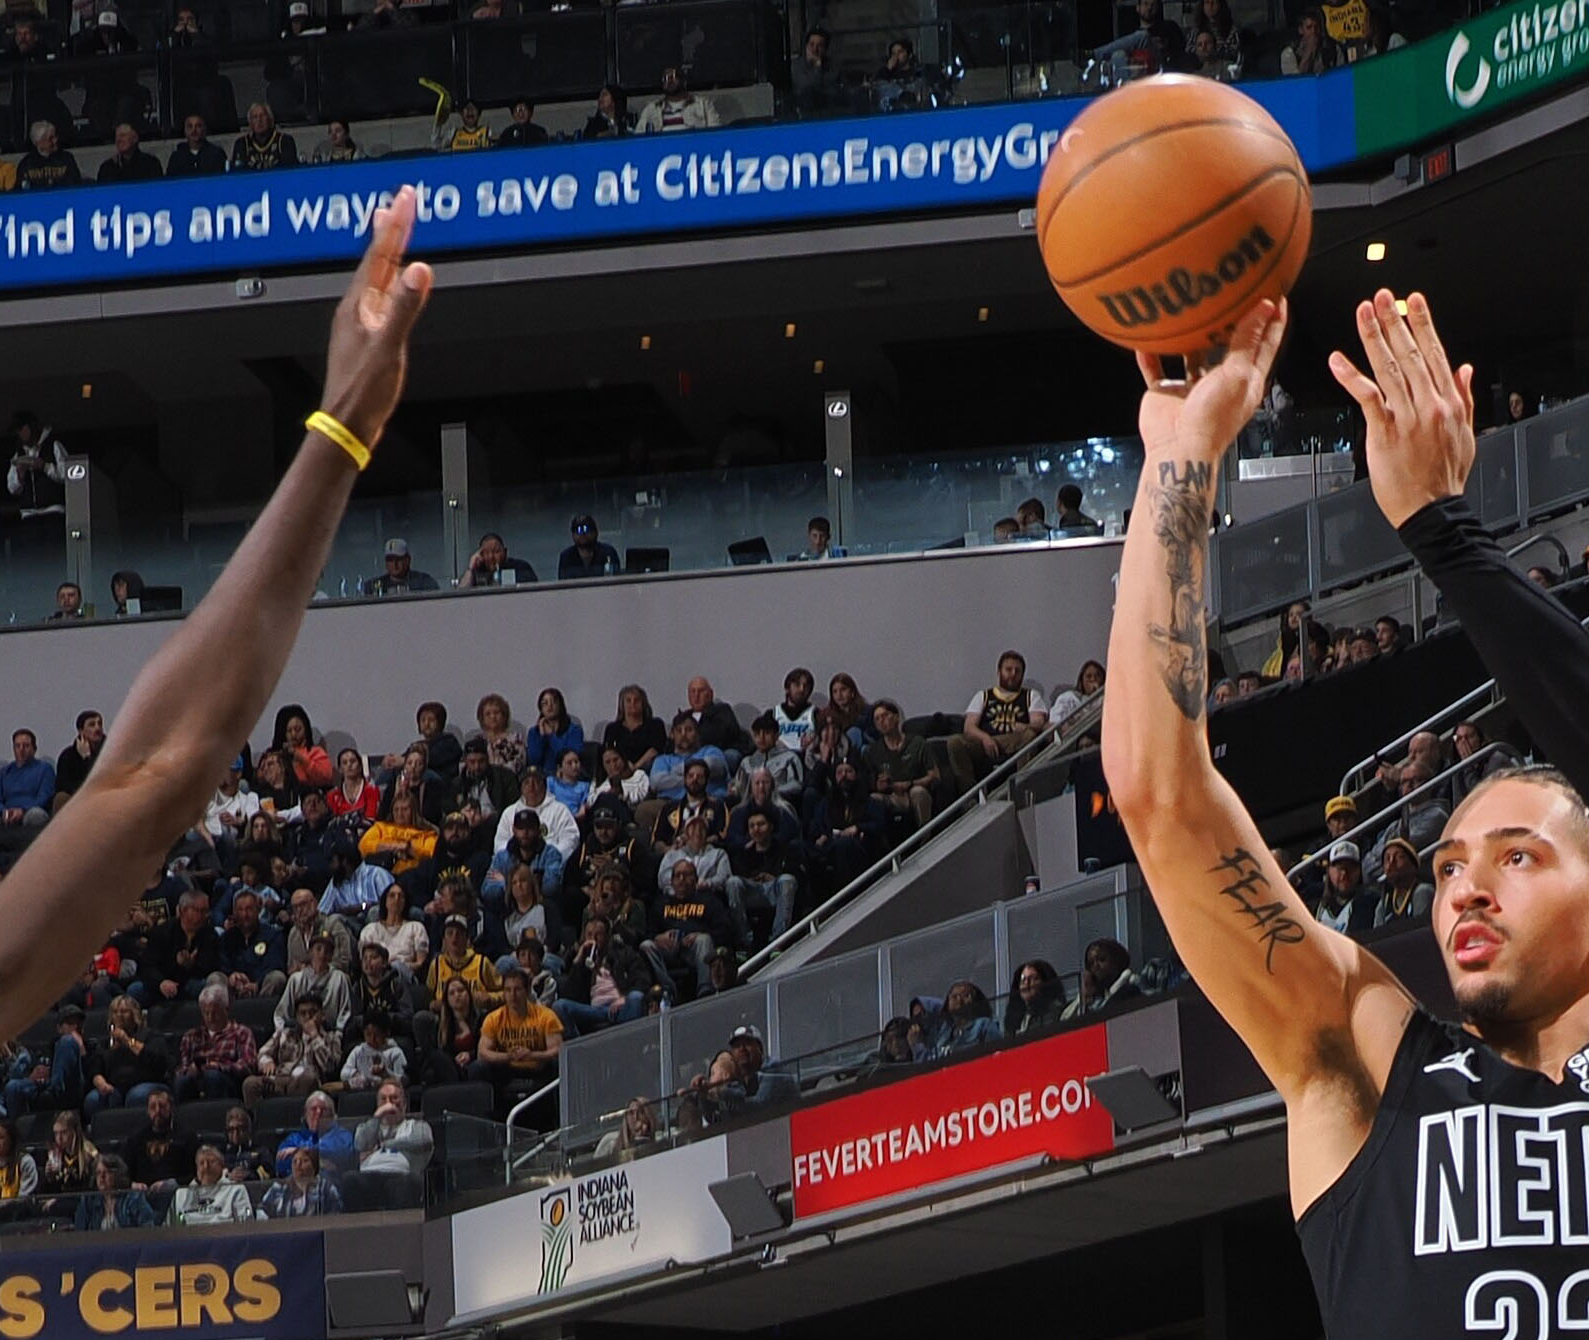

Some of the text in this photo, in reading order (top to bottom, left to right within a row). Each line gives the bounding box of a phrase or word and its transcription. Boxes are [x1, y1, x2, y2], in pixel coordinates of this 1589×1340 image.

[1496, 42, 1556, 88] energy
[90, 204, 174, 260] tips
[189, 191, 271, 242] and
[415, 179, 461, 221] to
[477, 174, 578, 217] save
[594, 162, 639, 206] at
[655, 124, 1055, 200] CitizensEnergyGr
[1099, 226, 1275, 329] Wilson
[1207, 847, 1305, 976] FEAR
[577, 1171, 630, 1202] INDIANA
[578, 1190, 634, 1224] SOYBEAN
[579, 1216, 635, 1247] ALLIANCE
[60, 1258, 282, 1335] 'CERS
